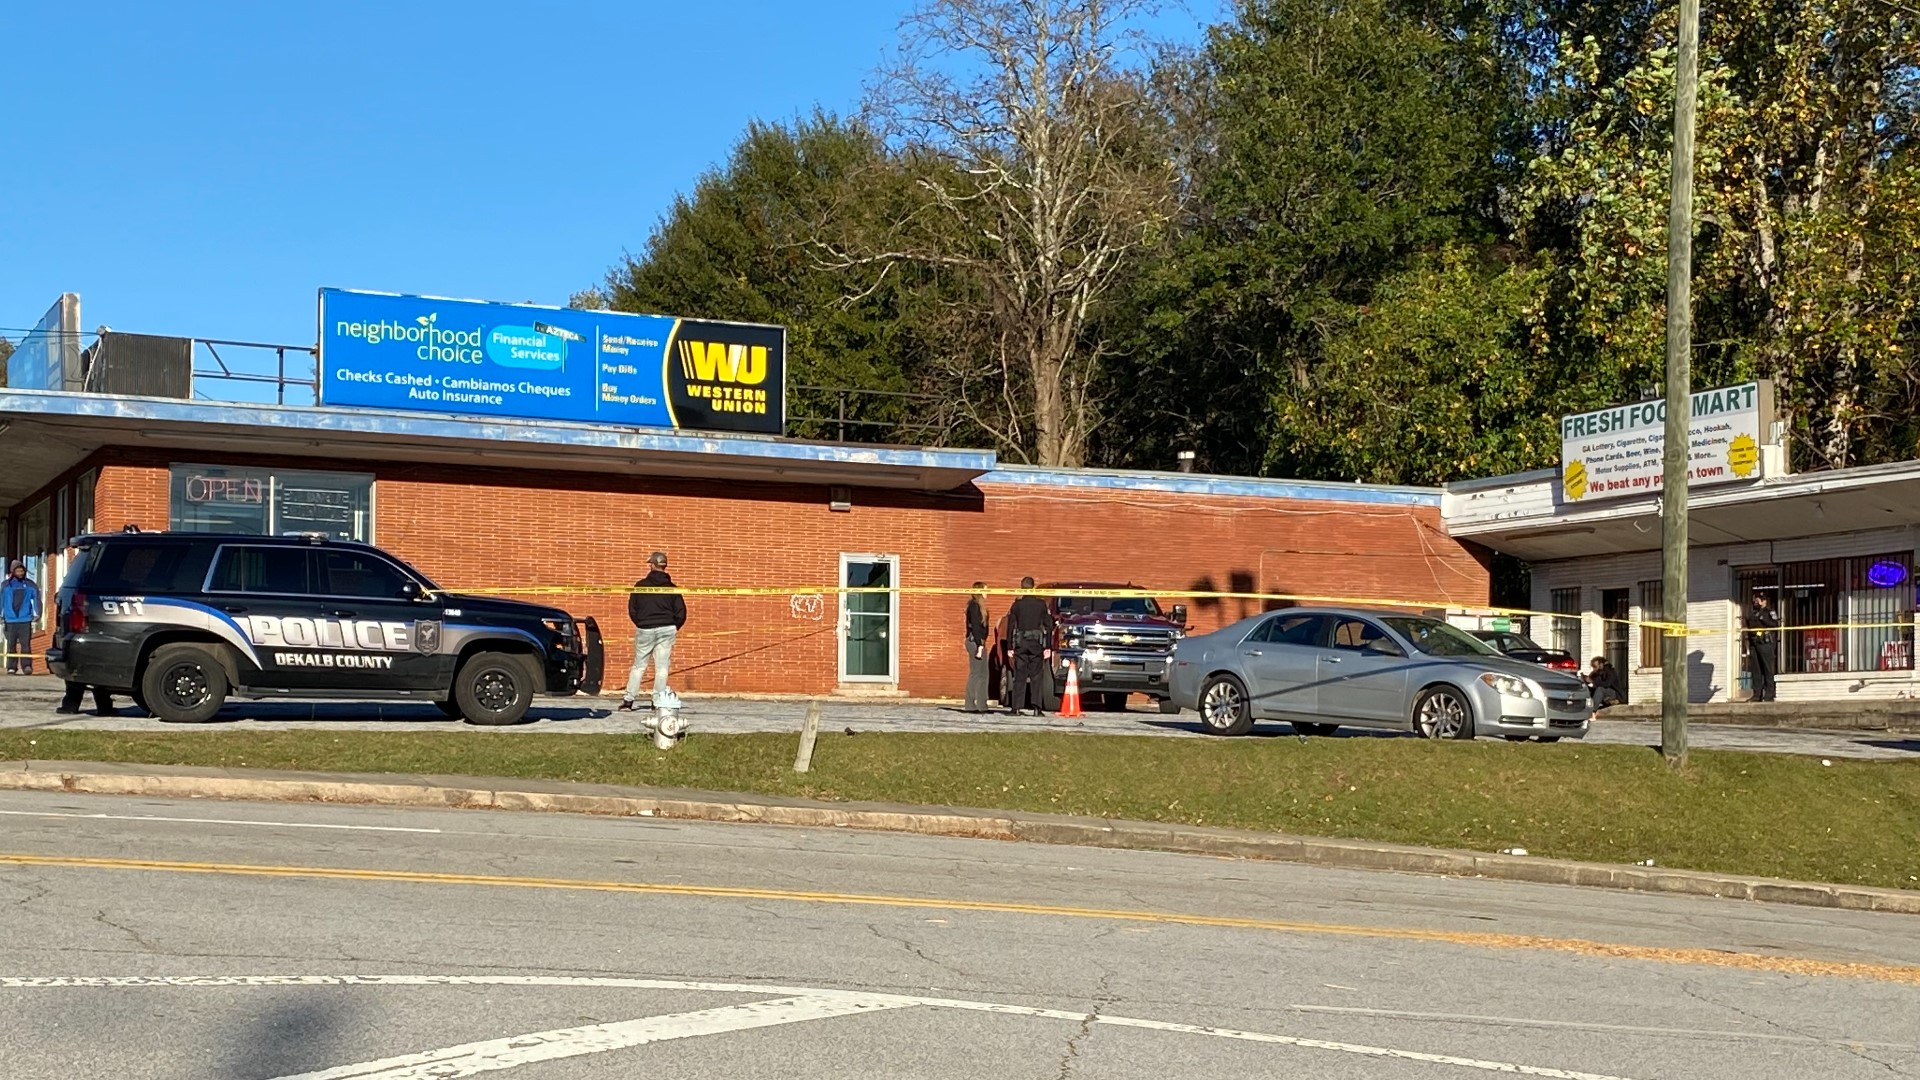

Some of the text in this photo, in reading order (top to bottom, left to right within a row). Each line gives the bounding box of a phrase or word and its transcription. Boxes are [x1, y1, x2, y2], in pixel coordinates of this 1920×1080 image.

[337, 319, 481, 347] neighborhood
[493, 332, 546, 348] Financial
[417, 345, 483, 364] choice
[510, 347, 560, 362] Services
[690, 341, 767, 385] WU
[602, 363, 617, 375] Pay
[336, 368, 571, 398] Checks Cashed Cambiamos Cheques
[408, 387, 503, 405] Auto Insurance
[686, 384, 766, 402] WESTERN
[711, 399, 766, 414] UNION
[1564, 385, 1756, 439] FRESH FOO MART
[1590, 481, 1605, 493] We
[1607, 477, 1630, 491] beat
[1632, 475, 1651, 488] any
[1696, 466, 1724, 479] town
[188, 476, 262, 503] OPEN
[102, 601, 144, 615] 911
[248, 615, 409, 651] POLICE
[275, 653, 392, 669] DEKALB COUNTY
